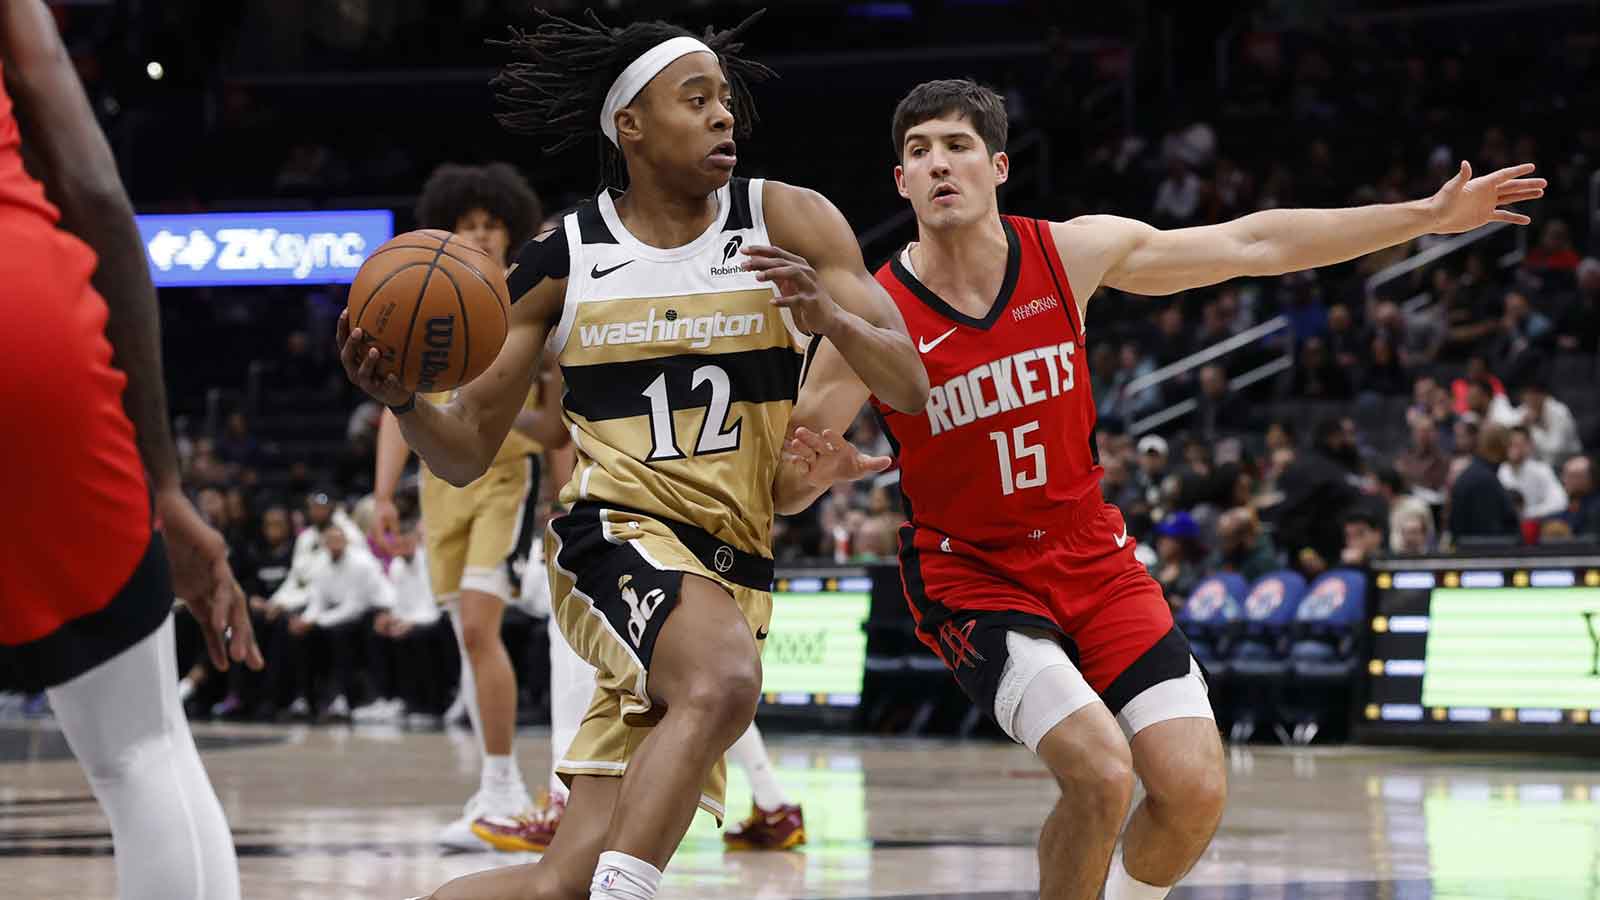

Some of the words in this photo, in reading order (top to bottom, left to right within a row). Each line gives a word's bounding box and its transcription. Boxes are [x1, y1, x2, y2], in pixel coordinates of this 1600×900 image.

[711, 264, 747, 276] Robinh
[579, 309, 763, 348] washington
[641, 365, 743, 463] 12
[925, 342, 1074, 436] ROCKETS
[990, 420, 1048, 496] 15
